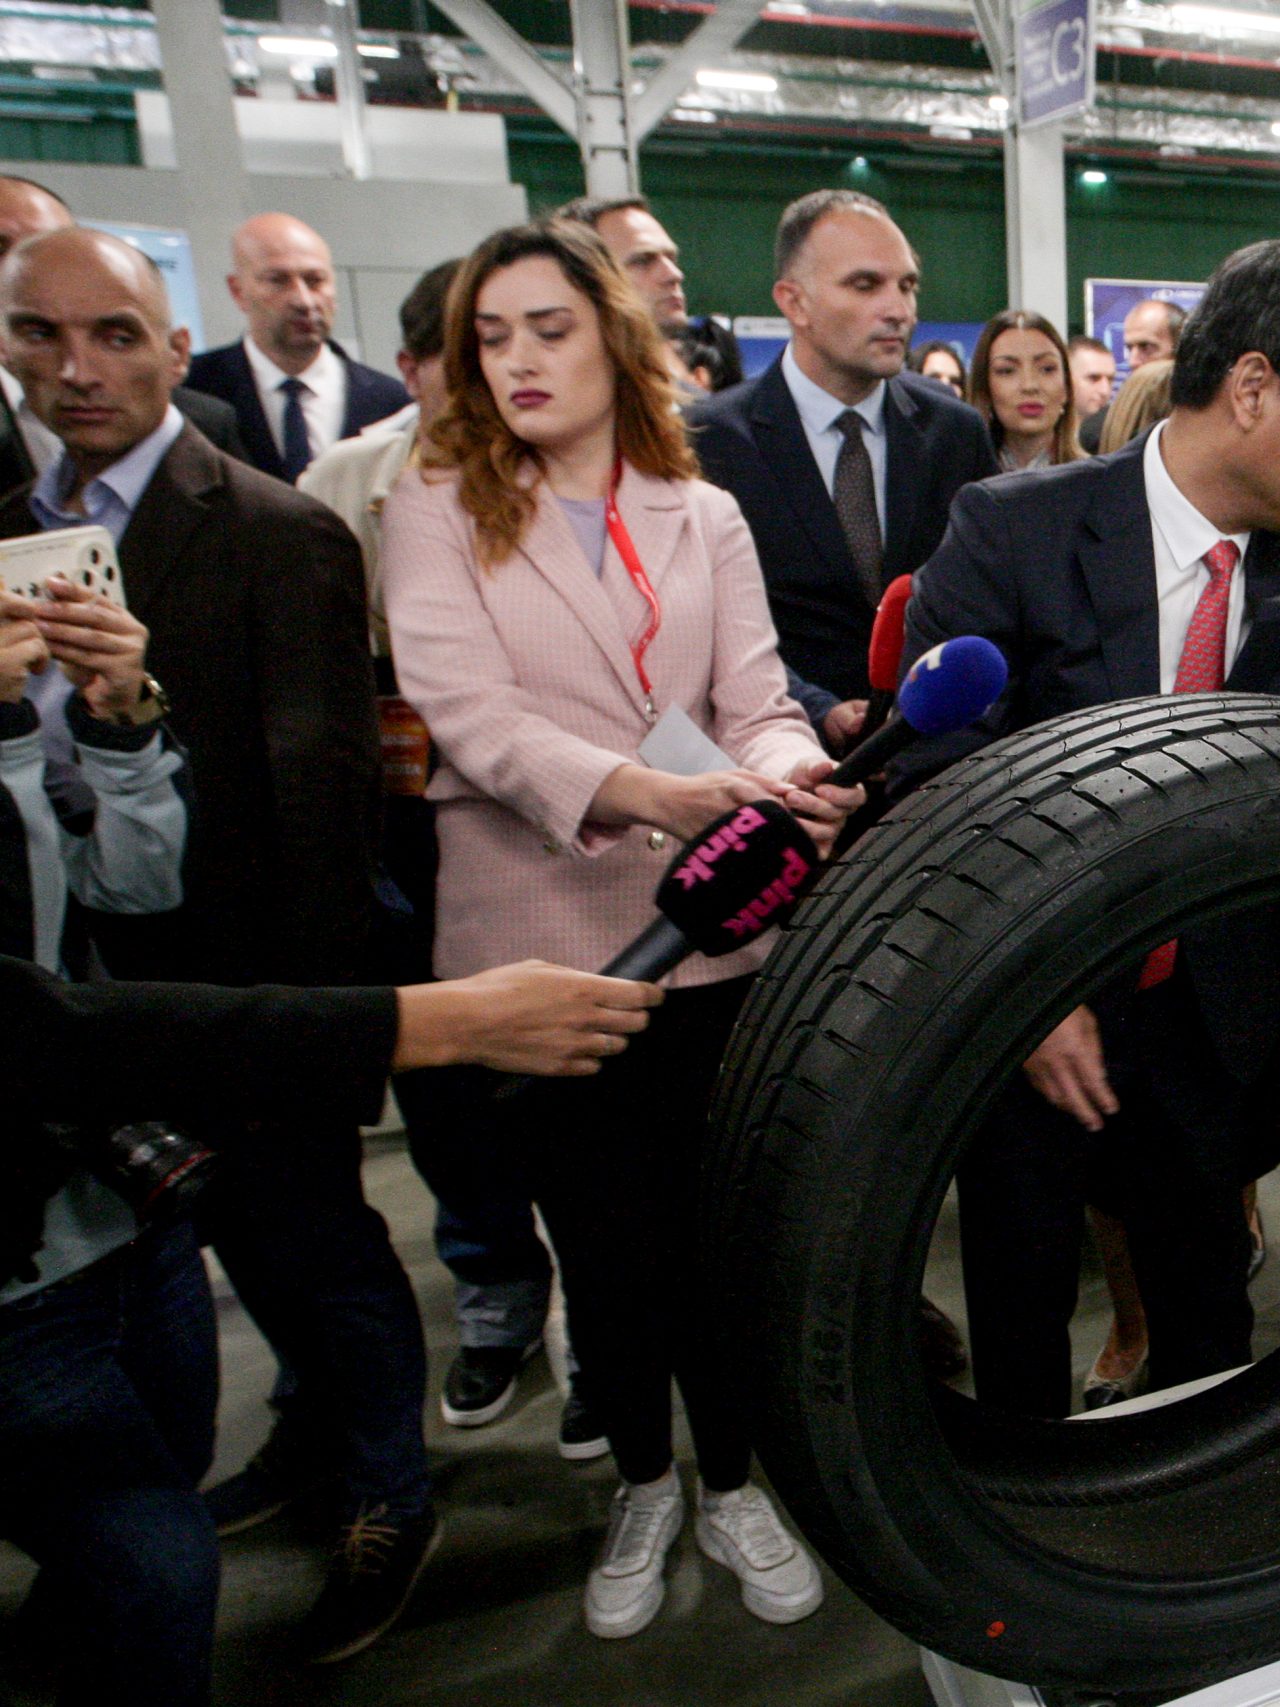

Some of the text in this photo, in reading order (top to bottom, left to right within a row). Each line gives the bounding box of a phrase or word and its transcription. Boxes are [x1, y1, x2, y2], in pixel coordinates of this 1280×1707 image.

[1052, 16, 1085, 85] C3
[672, 805, 768, 890] pink
[722, 847, 810, 937] pink
